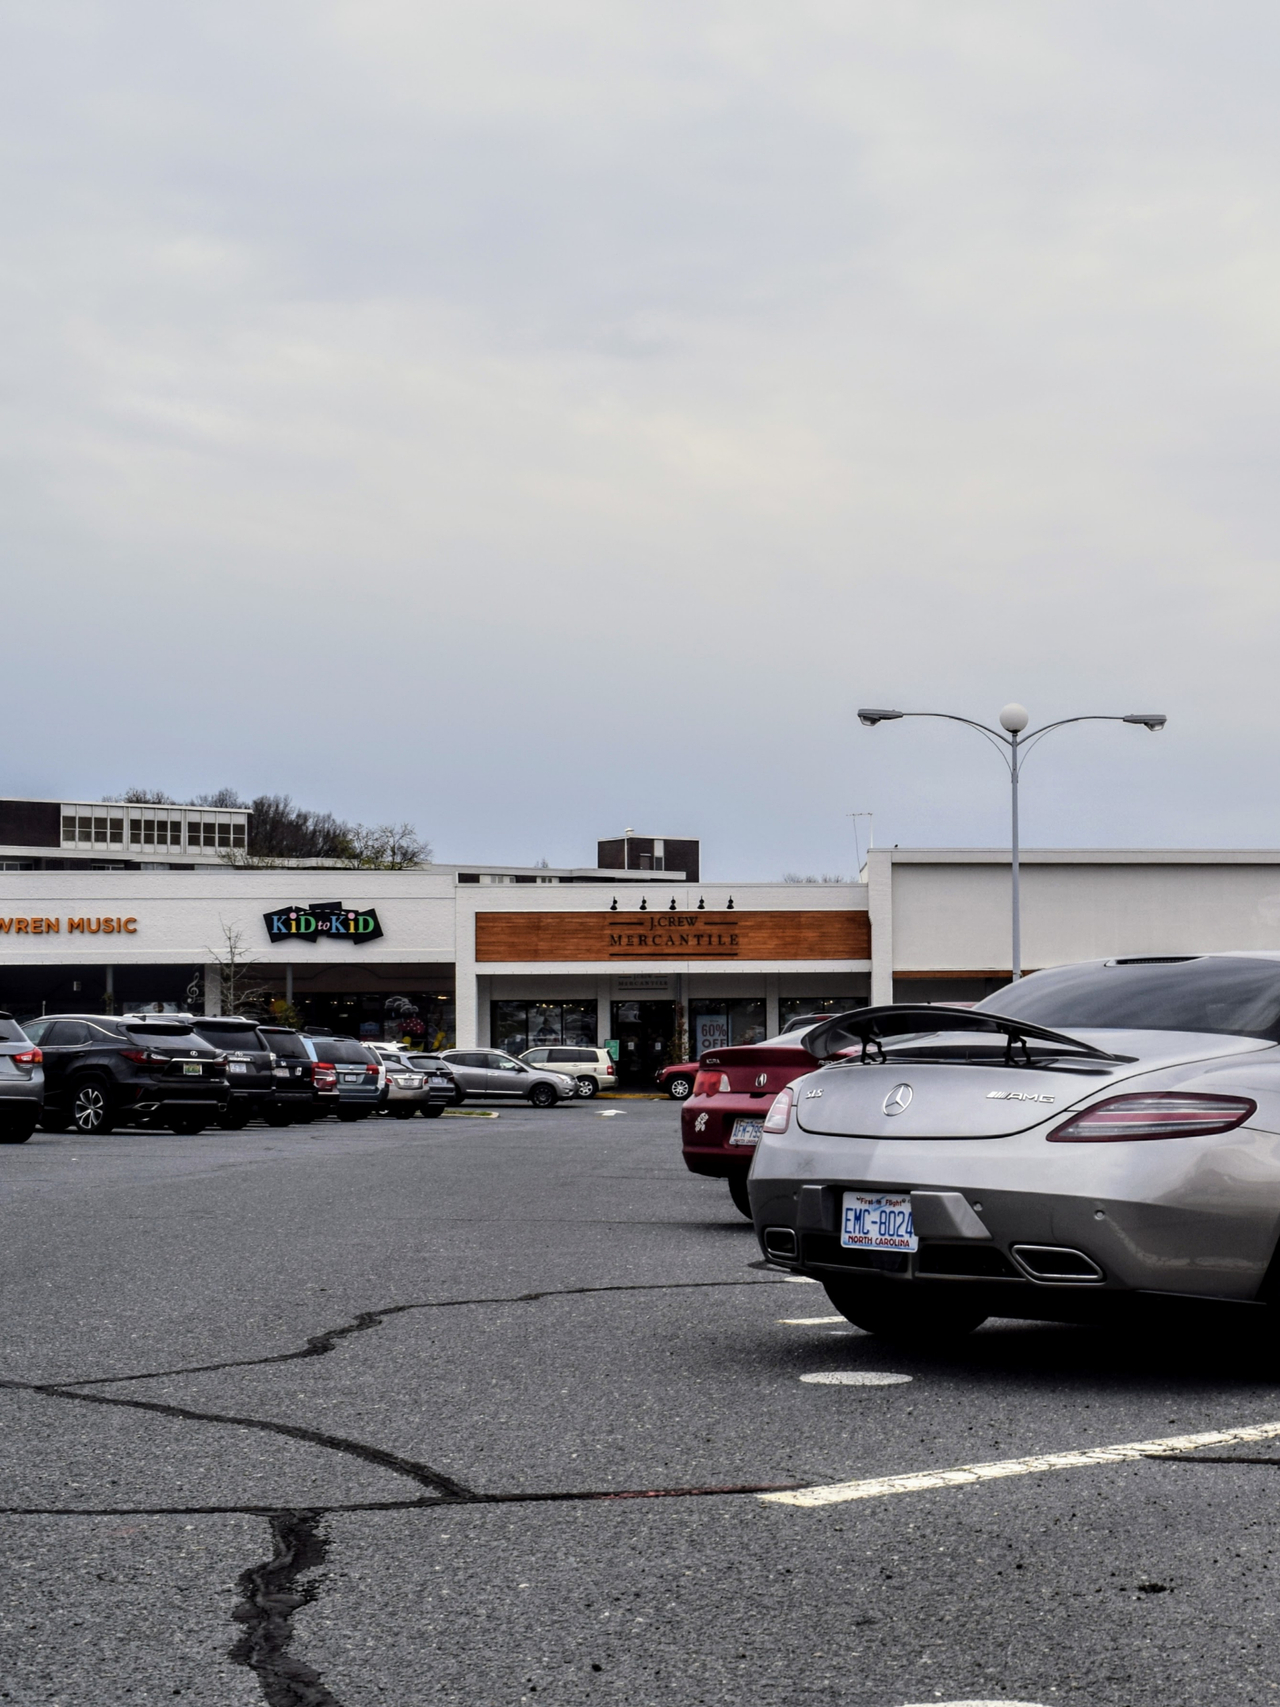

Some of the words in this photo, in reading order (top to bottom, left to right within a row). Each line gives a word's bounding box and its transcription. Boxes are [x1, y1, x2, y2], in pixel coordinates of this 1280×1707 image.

[68, 917, 137, 934] MUSIC
[317, 920, 330, 930] to
[649, 916, 698, 931] J.CREW
[610, 934, 739, 946] MERCANTILE
[701, 1024, 727, 1037] 60%
[701, 1038, 727, 1049] OFF
[805, 1089, 823, 1099] SLS
[1006, 1092, 1055, 1103] AMG
[844, 1207, 914, 1238] EMC-8024
[847, 1235, 873, 1245] NORTH
[875, 1237, 910, 1248] CAROLINA
